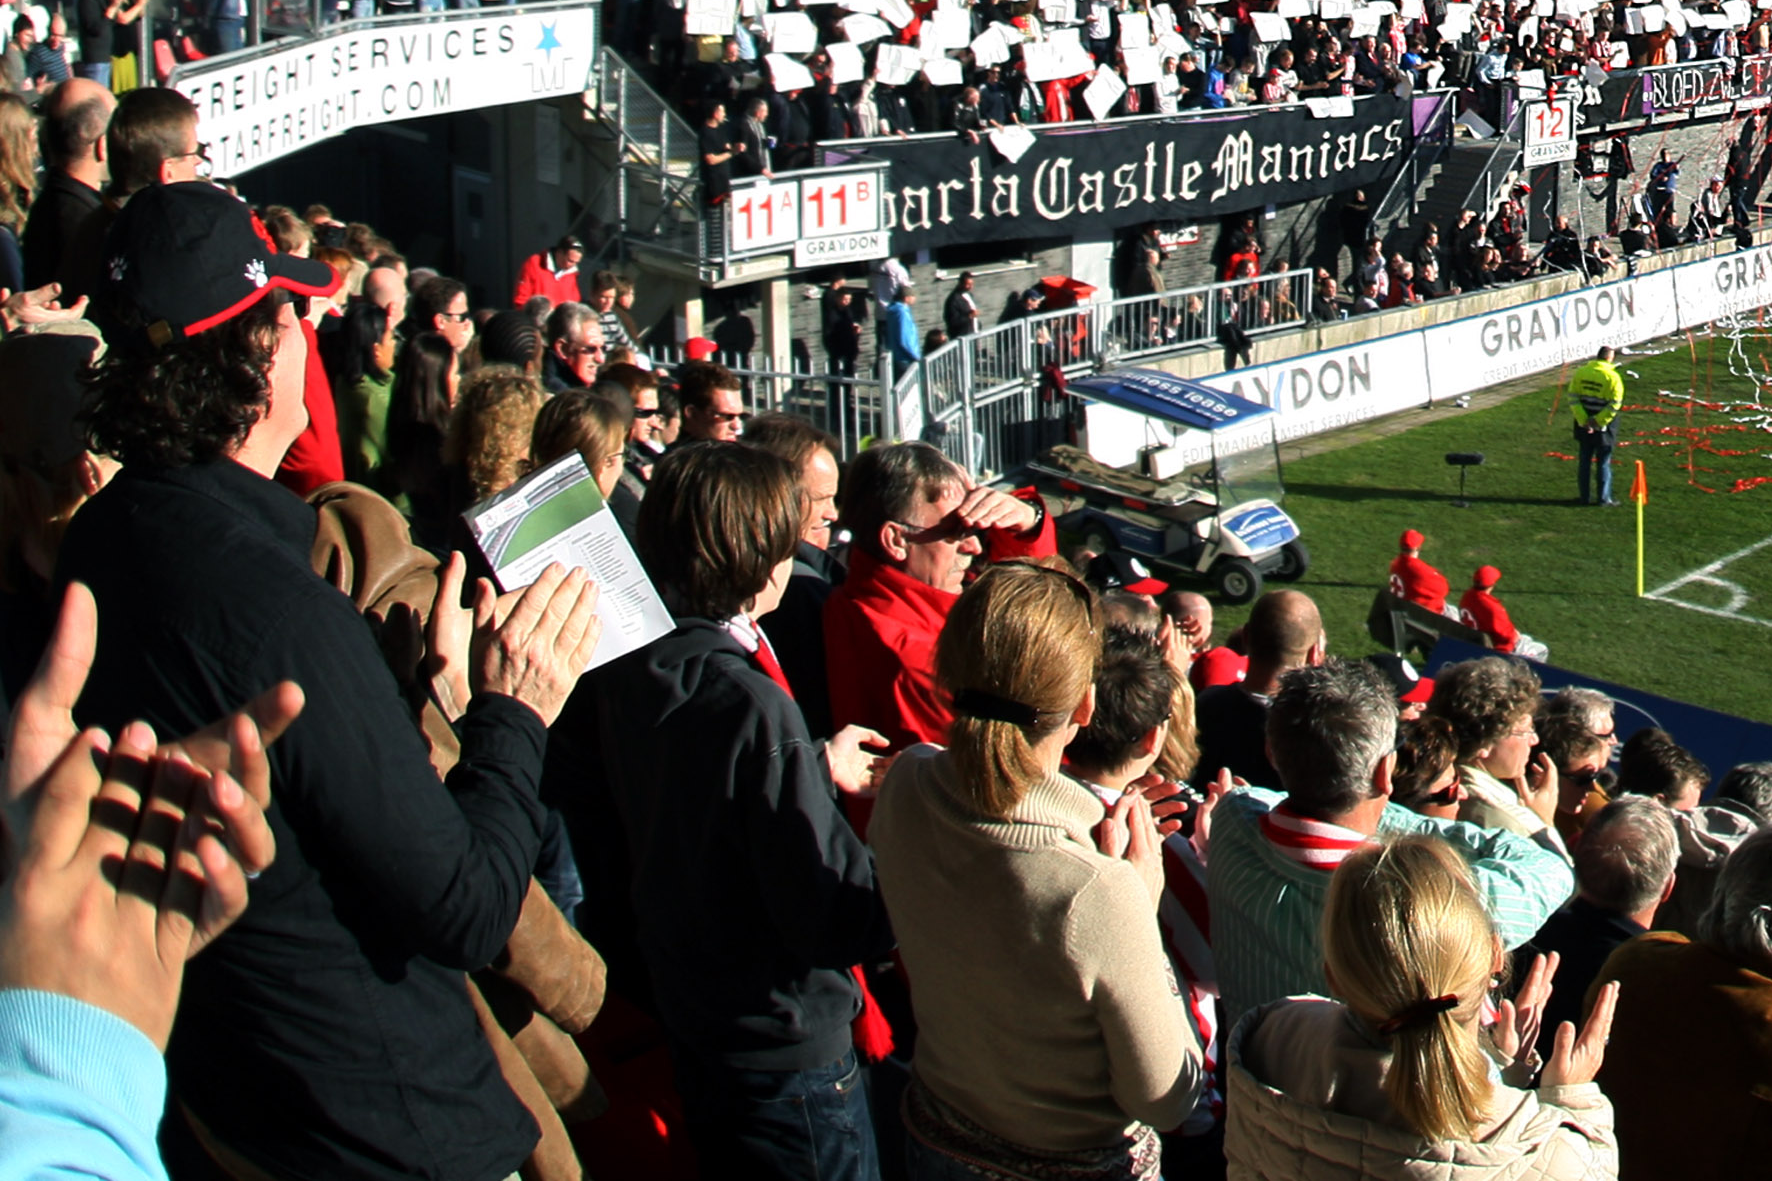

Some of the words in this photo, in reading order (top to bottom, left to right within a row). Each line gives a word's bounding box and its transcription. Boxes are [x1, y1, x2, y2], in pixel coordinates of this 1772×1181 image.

[189, 53, 316, 121] FREIGHT
[330, 23, 516, 79] SERVICES
[1536, 106, 1564, 139] 12
[1033, 142, 1204, 220] Castle
[1210, 118, 1405, 203] Maniacs
[806, 235, 879, 256] GRAYDON
[1480, 284, 1636, 357] GRAYDON
[1184, 392, 1238, 417] lease
[1217, 420, 1317, 456] MANAGEMENT
[1320, 404, 1377, 431] SERVICES
